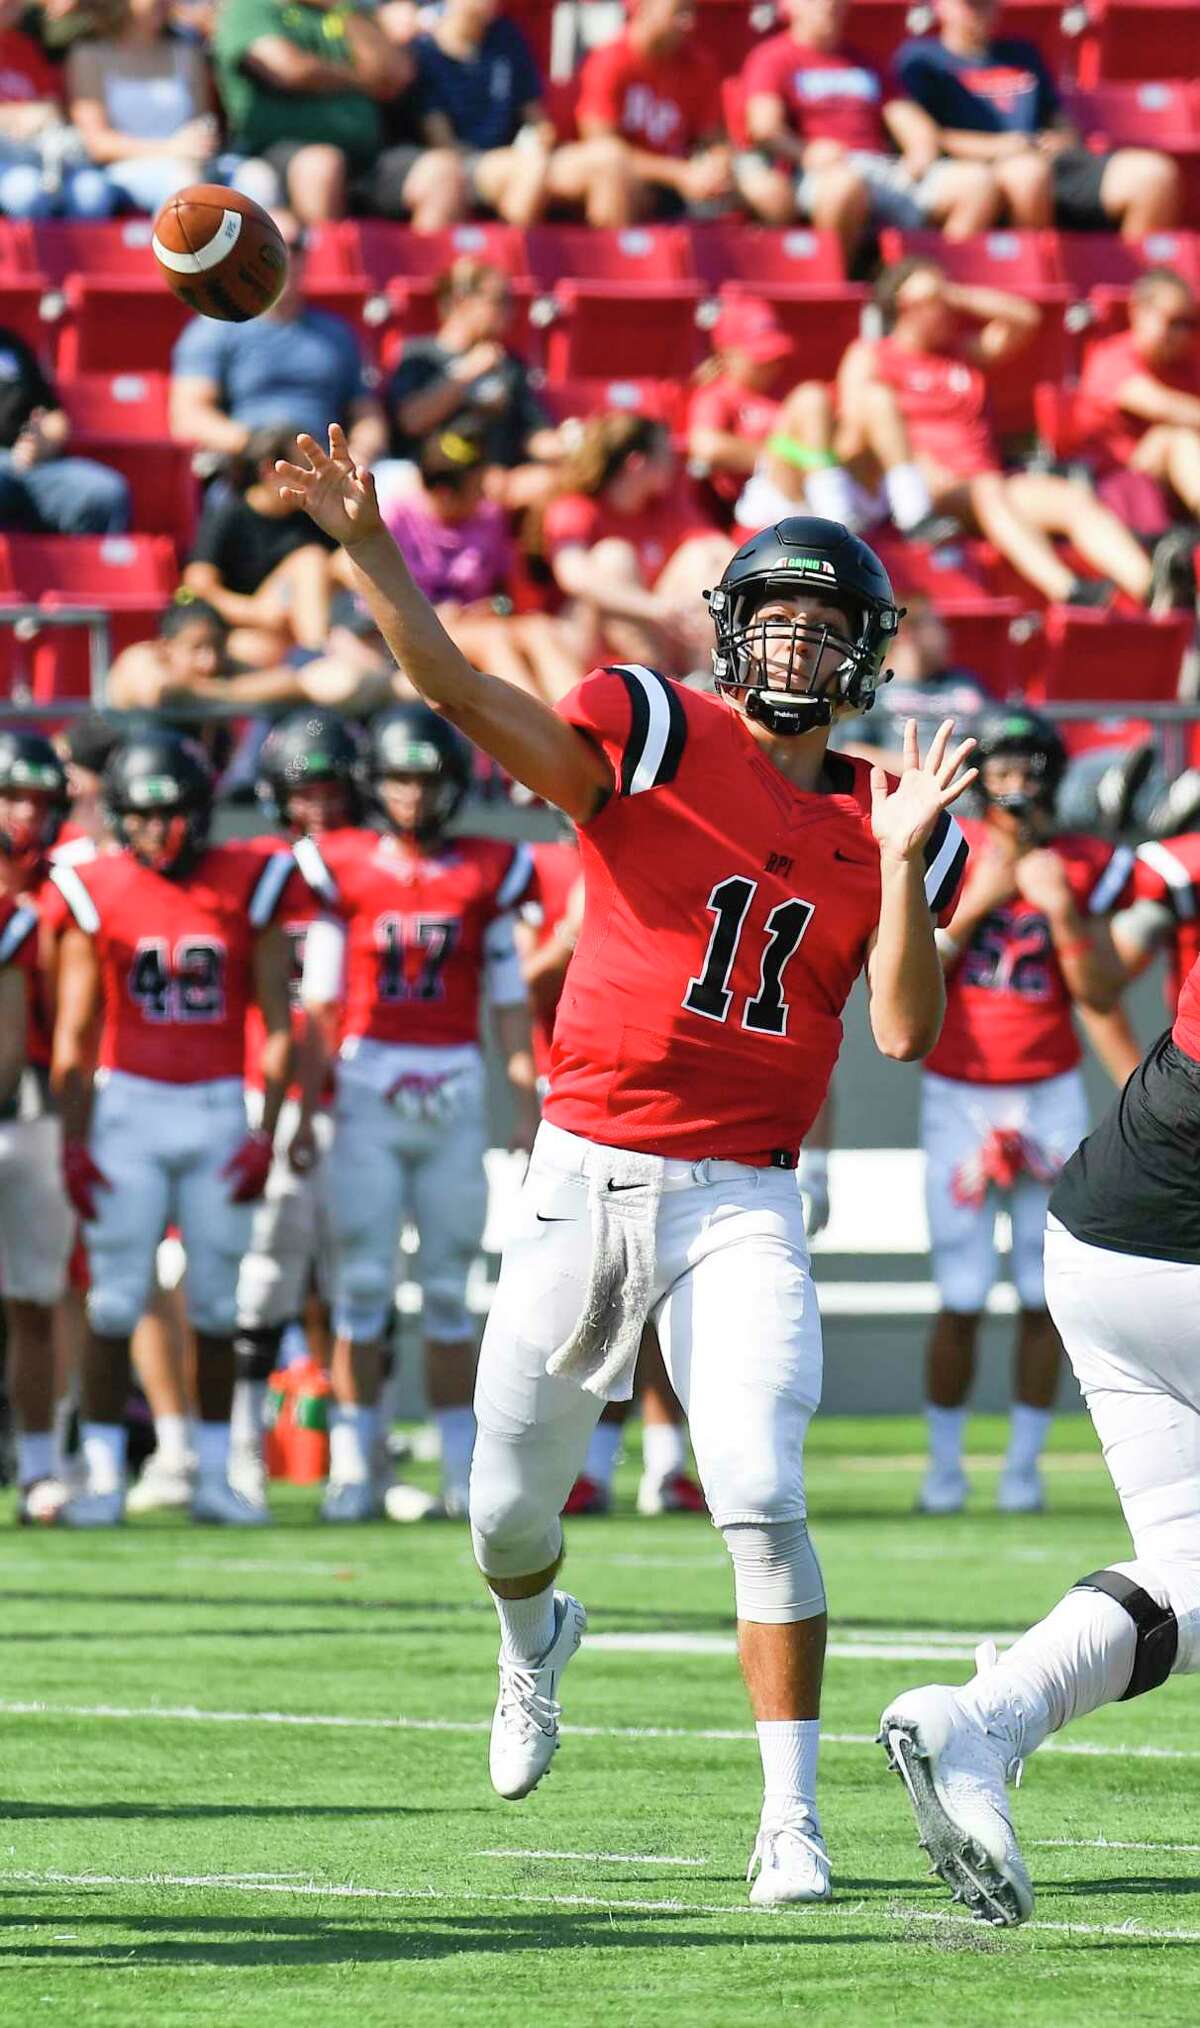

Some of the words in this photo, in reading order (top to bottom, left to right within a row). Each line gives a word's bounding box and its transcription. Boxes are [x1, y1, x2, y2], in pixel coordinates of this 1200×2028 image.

[788, 558, 820, 570] GRIND
[764, 851, 795, 879] RPI
[128, 935, 228, 1024] 42
[373, 910, 462, 1003] 17
[681, 874, 816, 1037] 11
[780, 1152, 786, 1165] L
